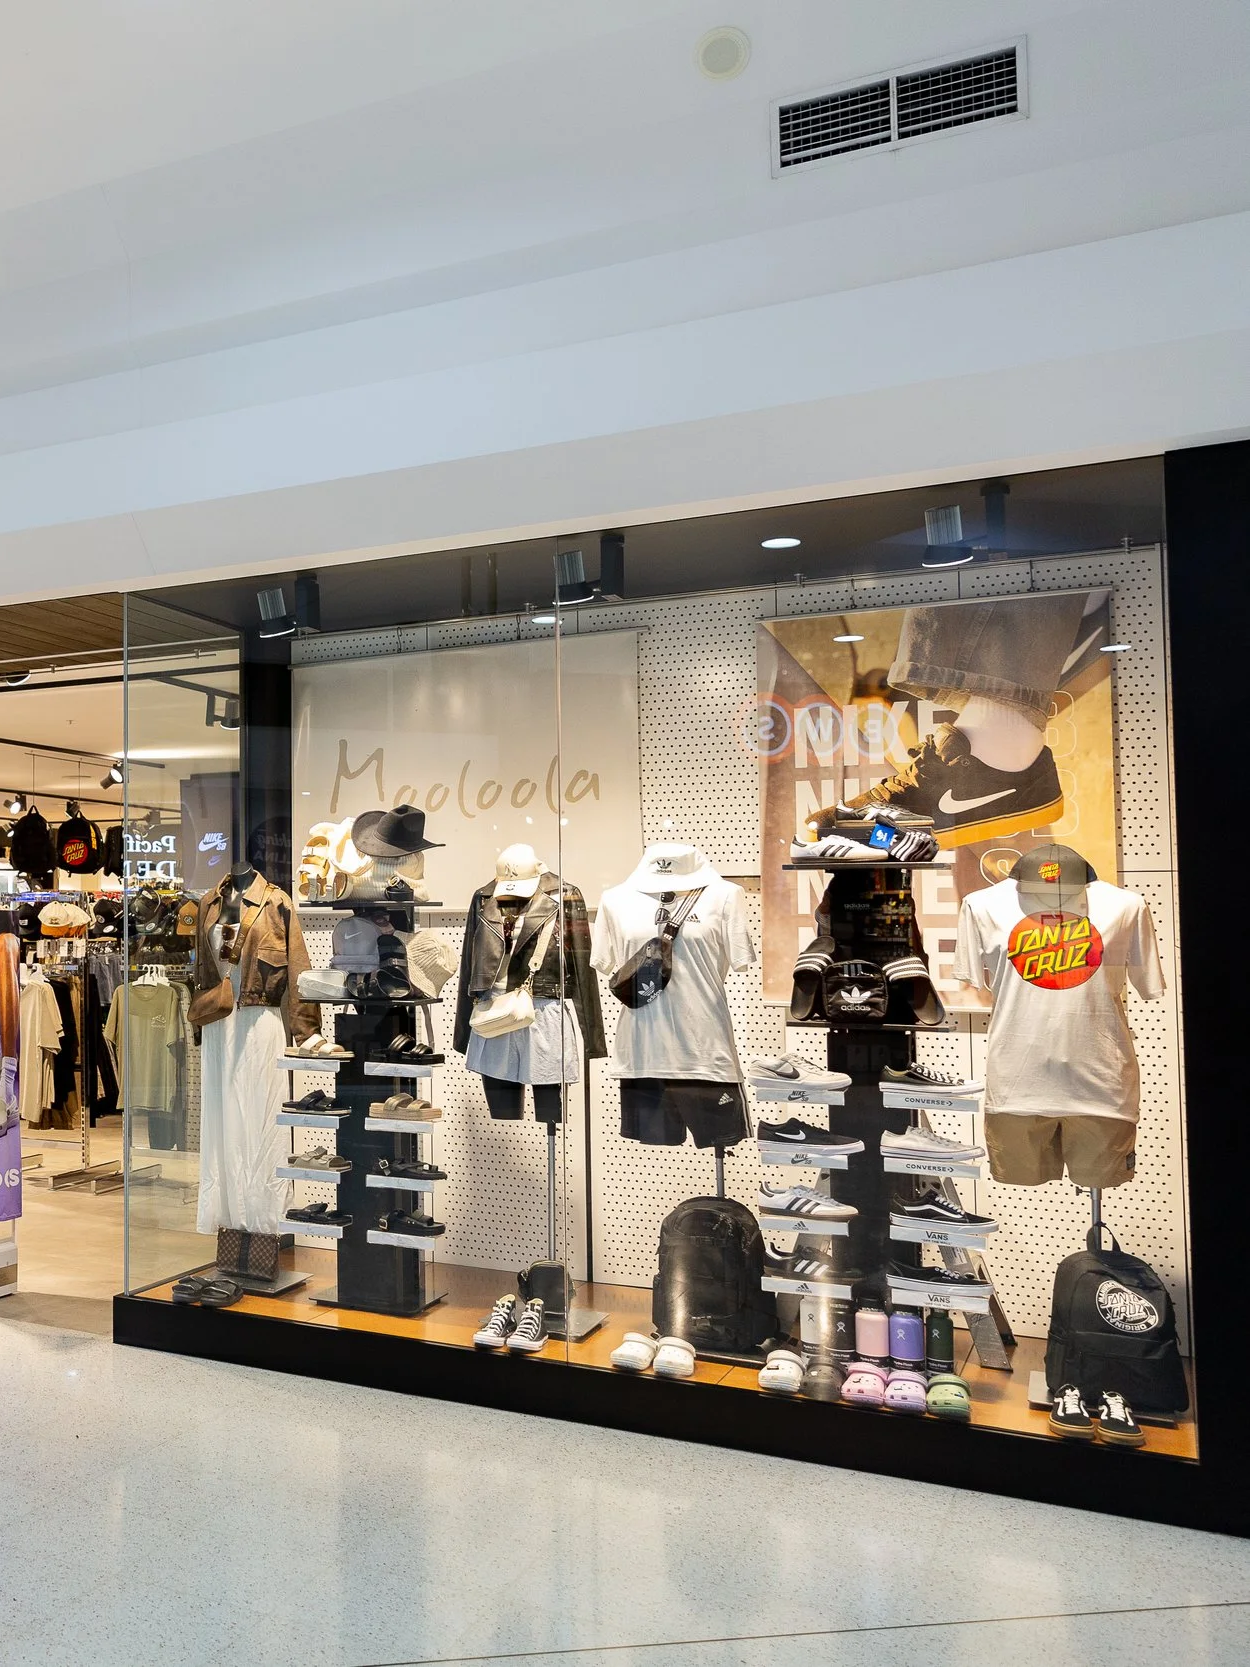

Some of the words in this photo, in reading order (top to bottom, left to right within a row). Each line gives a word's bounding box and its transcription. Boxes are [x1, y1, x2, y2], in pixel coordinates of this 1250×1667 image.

[330, 738, 600, 819] Mooloola
[203, 832, 223, 843] NIKE
[62, 843, 84, 856] SANTA
[66, 850, 85, 863] CRUZ
[1007, 915, 1093, 960] SANTA
[1021, 941, 1094, 981] CRUZ
[840, 1003, 871, 1011] adidas
[904, 1097, 947, 1106] CONVERSE
[905, 1163, 947, 1172] CONVERSE
